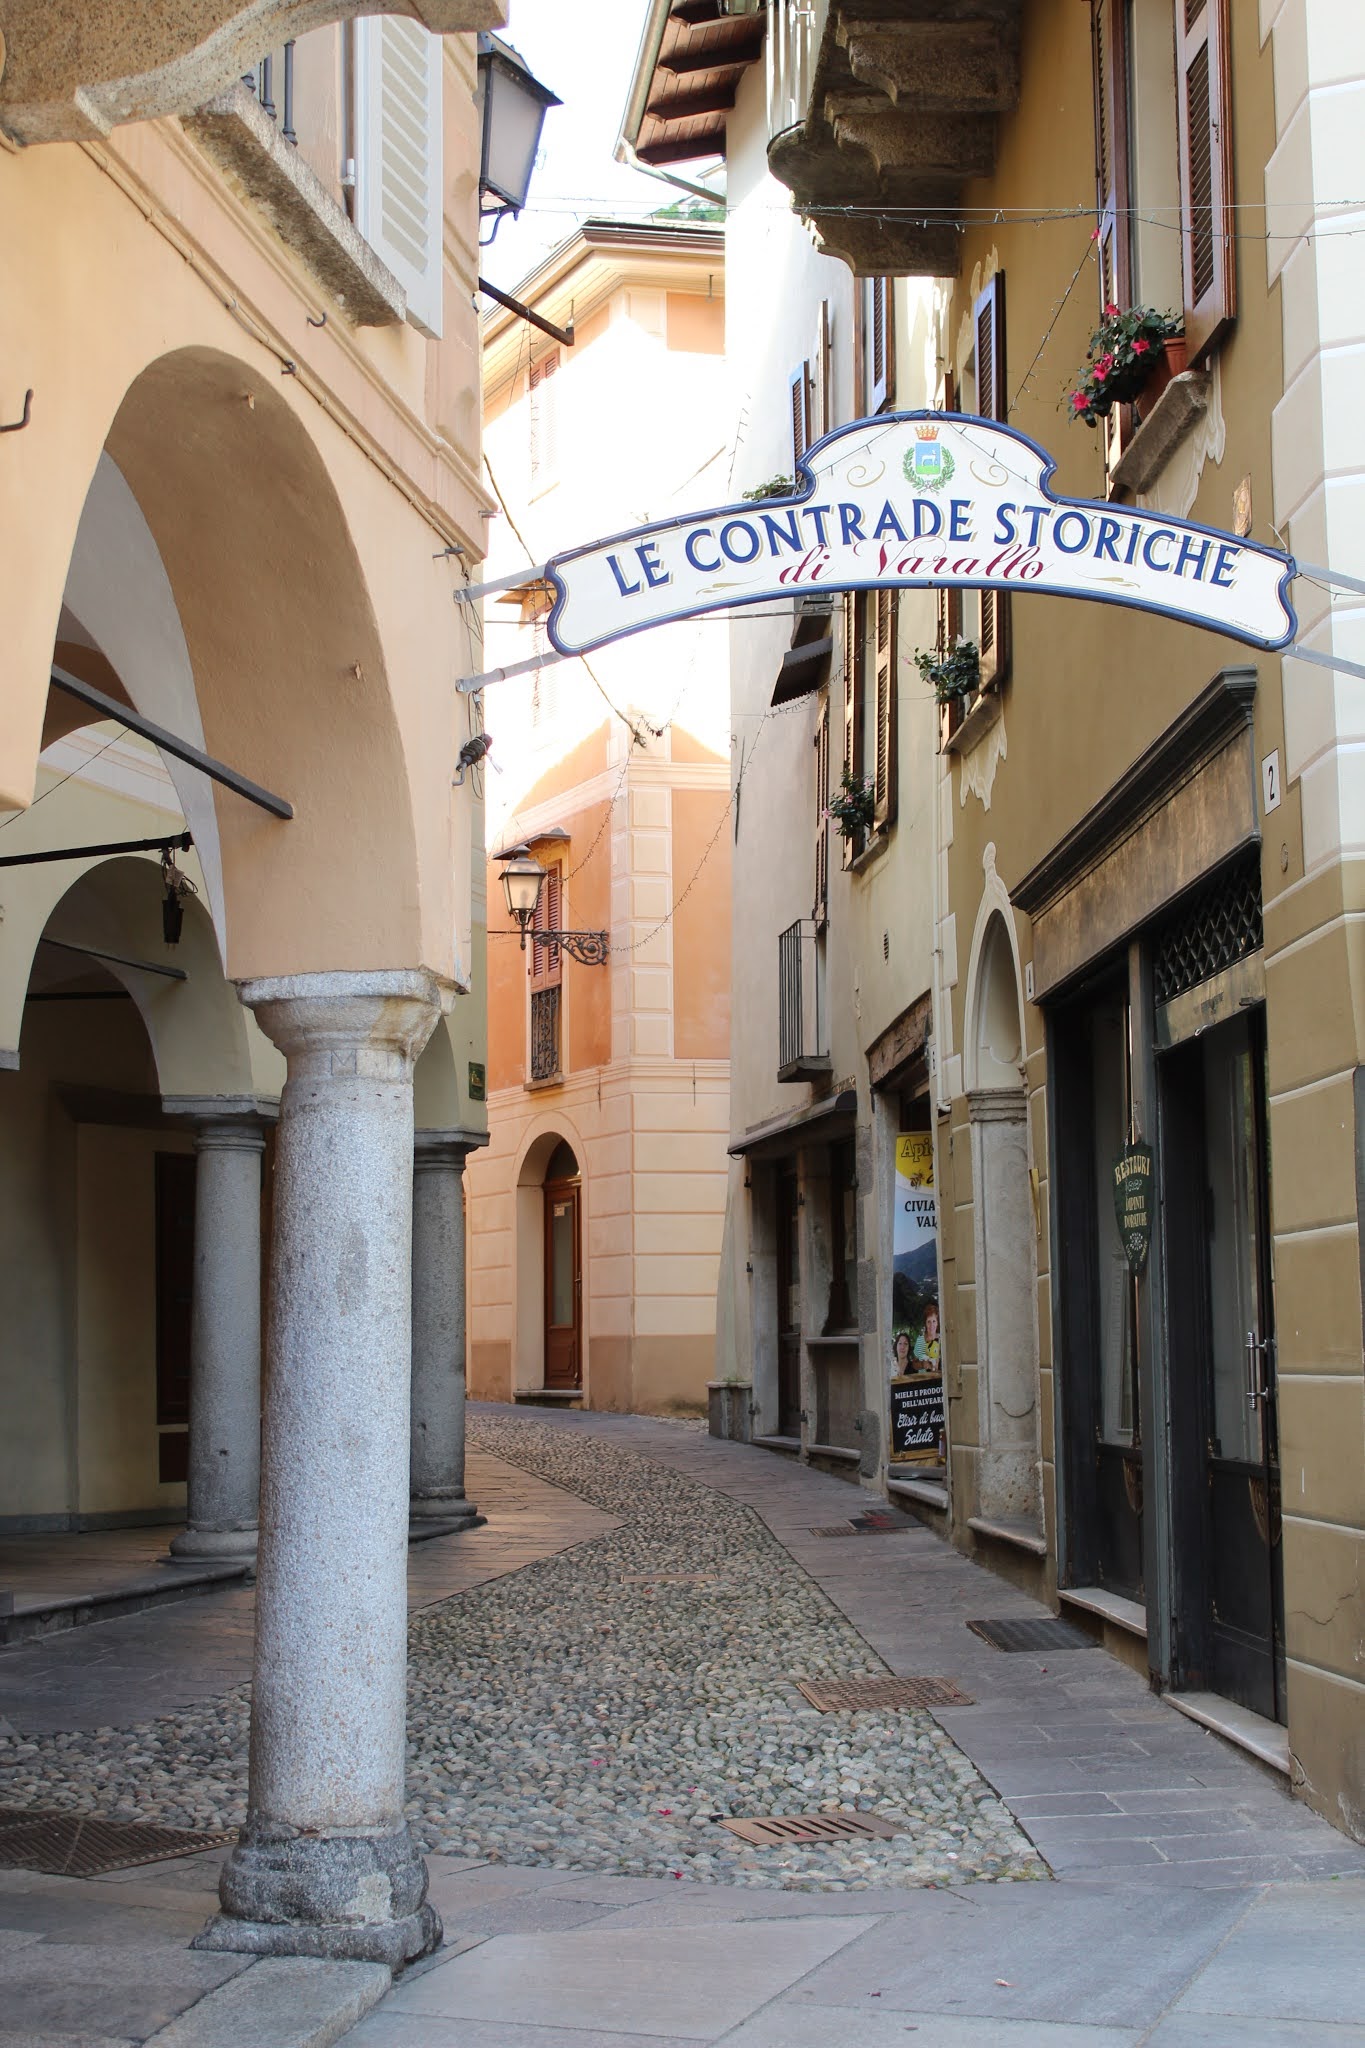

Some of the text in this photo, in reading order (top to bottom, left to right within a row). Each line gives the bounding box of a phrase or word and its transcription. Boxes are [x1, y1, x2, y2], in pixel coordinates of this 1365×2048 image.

[606, 498, 1240, 597] LE CONTRADE STORICHE
[778, 534, 1053, 584] di Varallo
[1268, 765, 1275, 801] 2
[1114, 1155, 1150, 1185] RESTAURI
[895, 1390, 914, 1400] MIELE
[914, 1389, 919, 1397] E
[897, 1413, 917, 1428] Elisir
[919, 1411, 929, 1425] di
[904, 1427, 934, 1446] Salute
